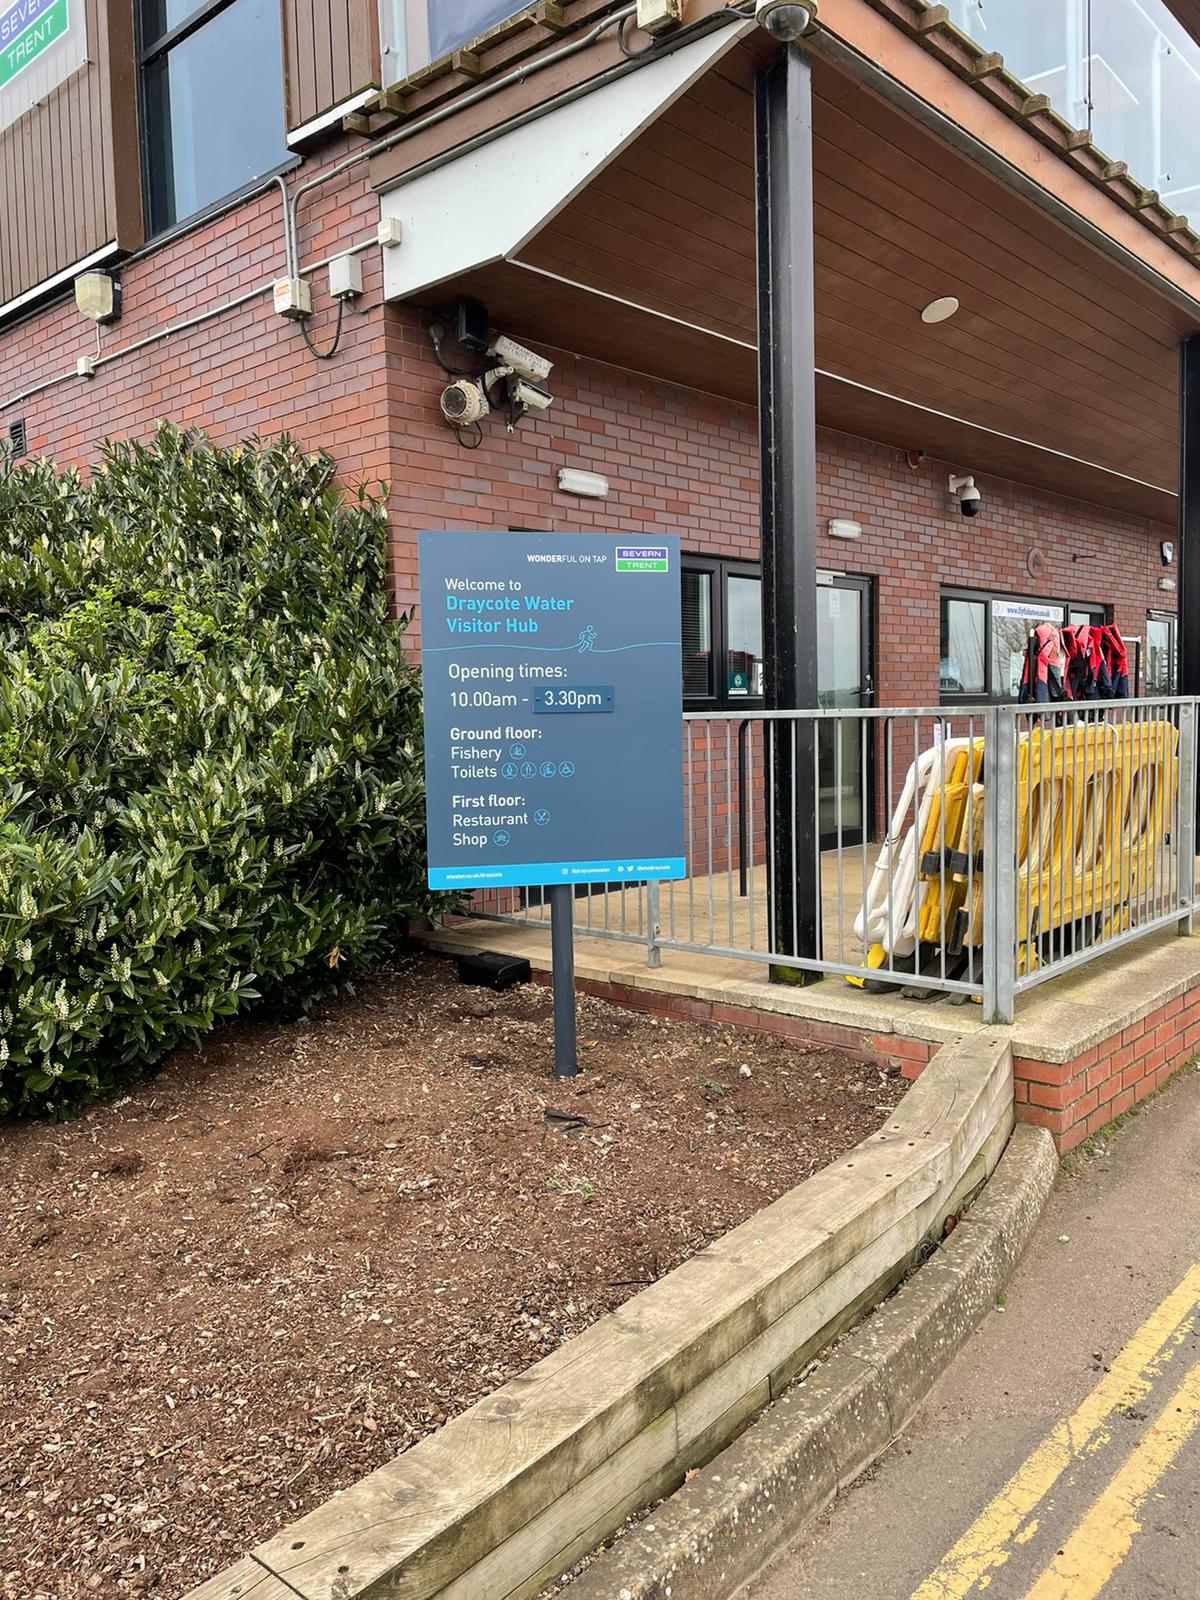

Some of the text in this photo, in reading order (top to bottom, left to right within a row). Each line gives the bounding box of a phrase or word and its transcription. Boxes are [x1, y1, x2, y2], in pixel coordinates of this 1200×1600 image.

[8, 14, 54, 69] TRENT
[527, 554, 607, 563] WONDERFUL ON TAP
[445, 578, 521, 591] Welcome to
[446, 596, 574, 613] Draycote Water
[447, 618, 538, 632] Visitor Hub
[449, 663, 567, 682] Opening times:
[451, 692, 517, 707] 10.00am
[544, 691, 602, 708] 3.30pm
[450, 727, 542, 740] Ground floor:
[451, 747, 501, 761] Fishery
[451, 765, 497, 778] Toilets
[452, 795, 525, 807] First floor:
[453, 813, 528, 826] Restaurant
[453, 833, 487, 848] Shop
